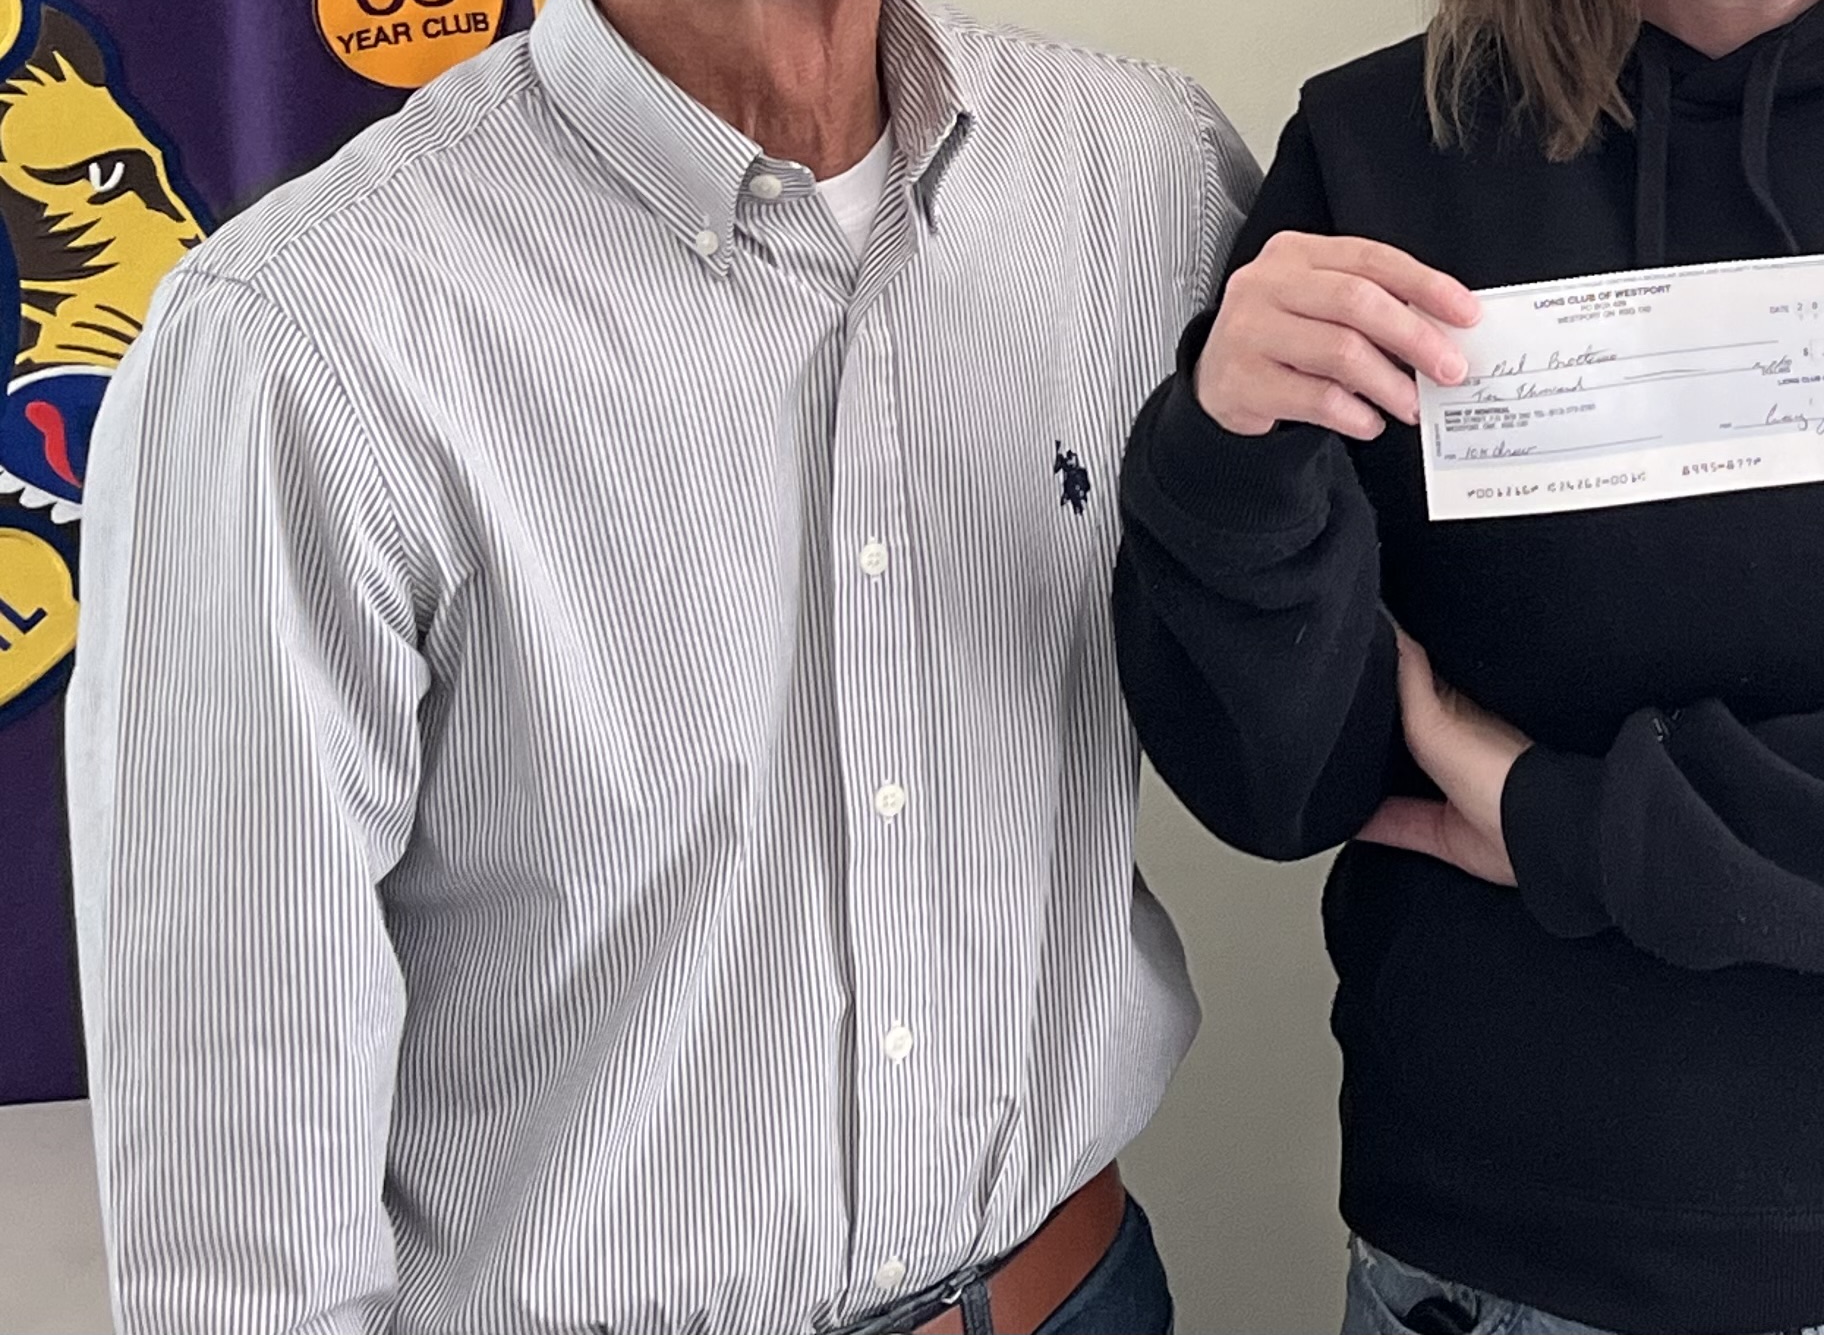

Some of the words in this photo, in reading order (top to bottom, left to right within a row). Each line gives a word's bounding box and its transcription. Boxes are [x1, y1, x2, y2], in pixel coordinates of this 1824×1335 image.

[336, 21, 412, 55] YEAR
[421, 10, 490, 40] CLUB
[1534, 297, 1566, 310] LIONS
[1567, 294, 1596, 306] CLUB
[1598, 290, 1612, 301] OF
[1615, 284, 1672, 299] WESTPORT
